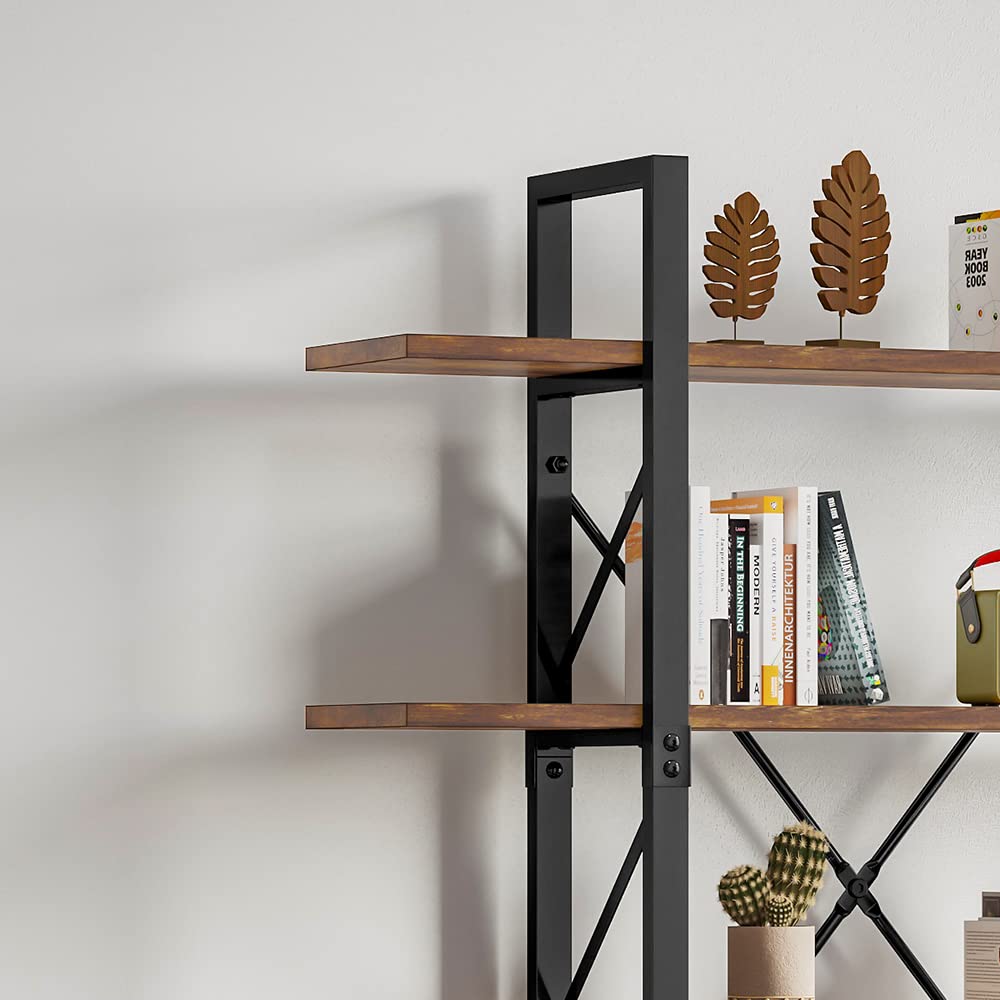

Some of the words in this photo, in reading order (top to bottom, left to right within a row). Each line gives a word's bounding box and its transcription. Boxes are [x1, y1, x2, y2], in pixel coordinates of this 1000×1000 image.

[736, 535, 745, 549] IN
[736, 550, 745, 572] THE
[736, 573, 745, 633] BEGINNING
[784, 553, 794, 684] INNENARCHITEKTUR
